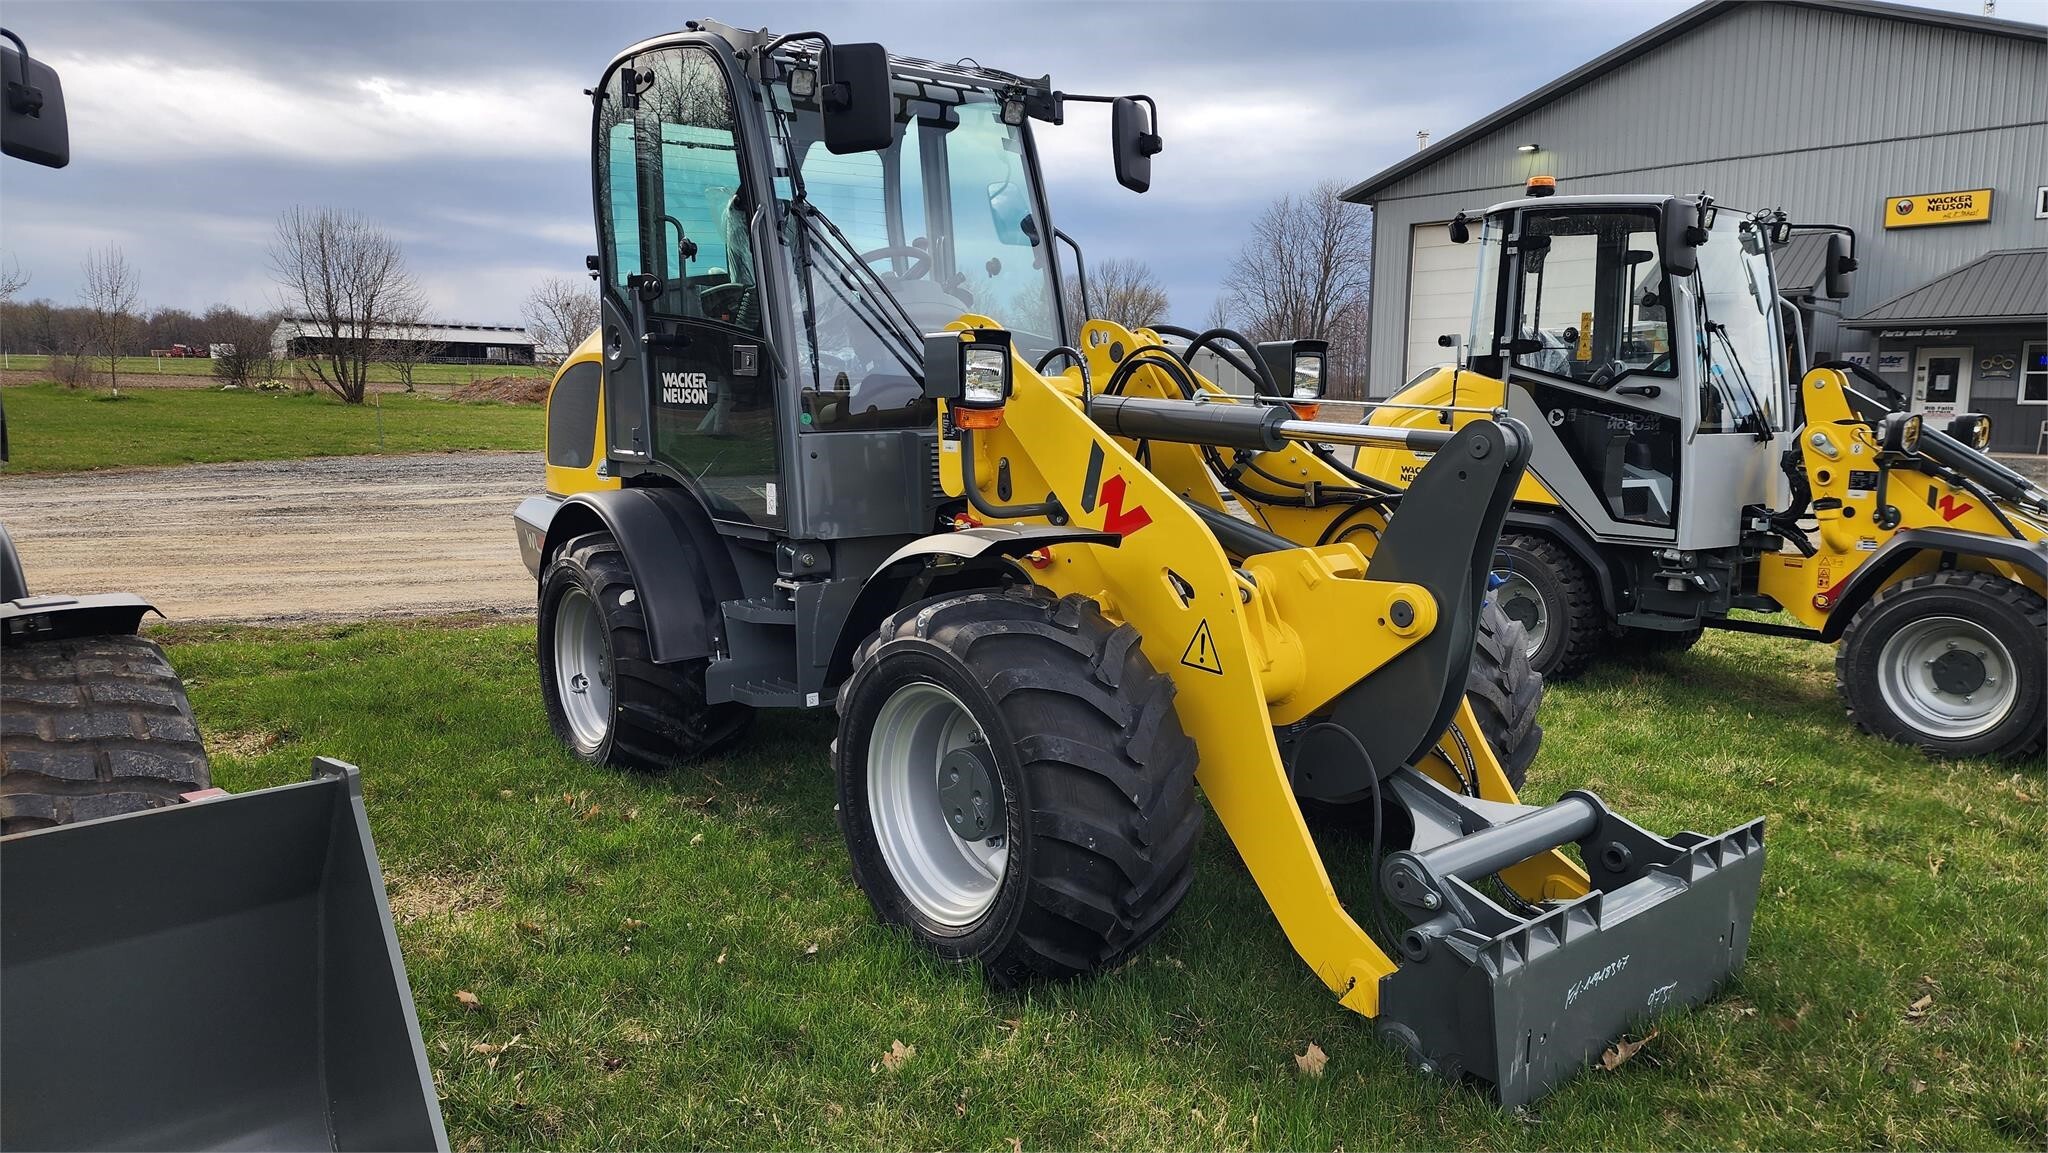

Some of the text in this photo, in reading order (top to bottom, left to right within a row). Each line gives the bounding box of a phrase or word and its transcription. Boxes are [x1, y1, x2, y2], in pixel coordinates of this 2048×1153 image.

[1927, 195, 1972, 205] WACKER
[1927, 202, 1972, 212] NEUSON
[1880, 328, 1958, 337] Parts and Service
[662, 372, 707, 388] WACKER
[663, 388, 708, 404] NEUSON
[1401, 466, 1421, 474] WAC
